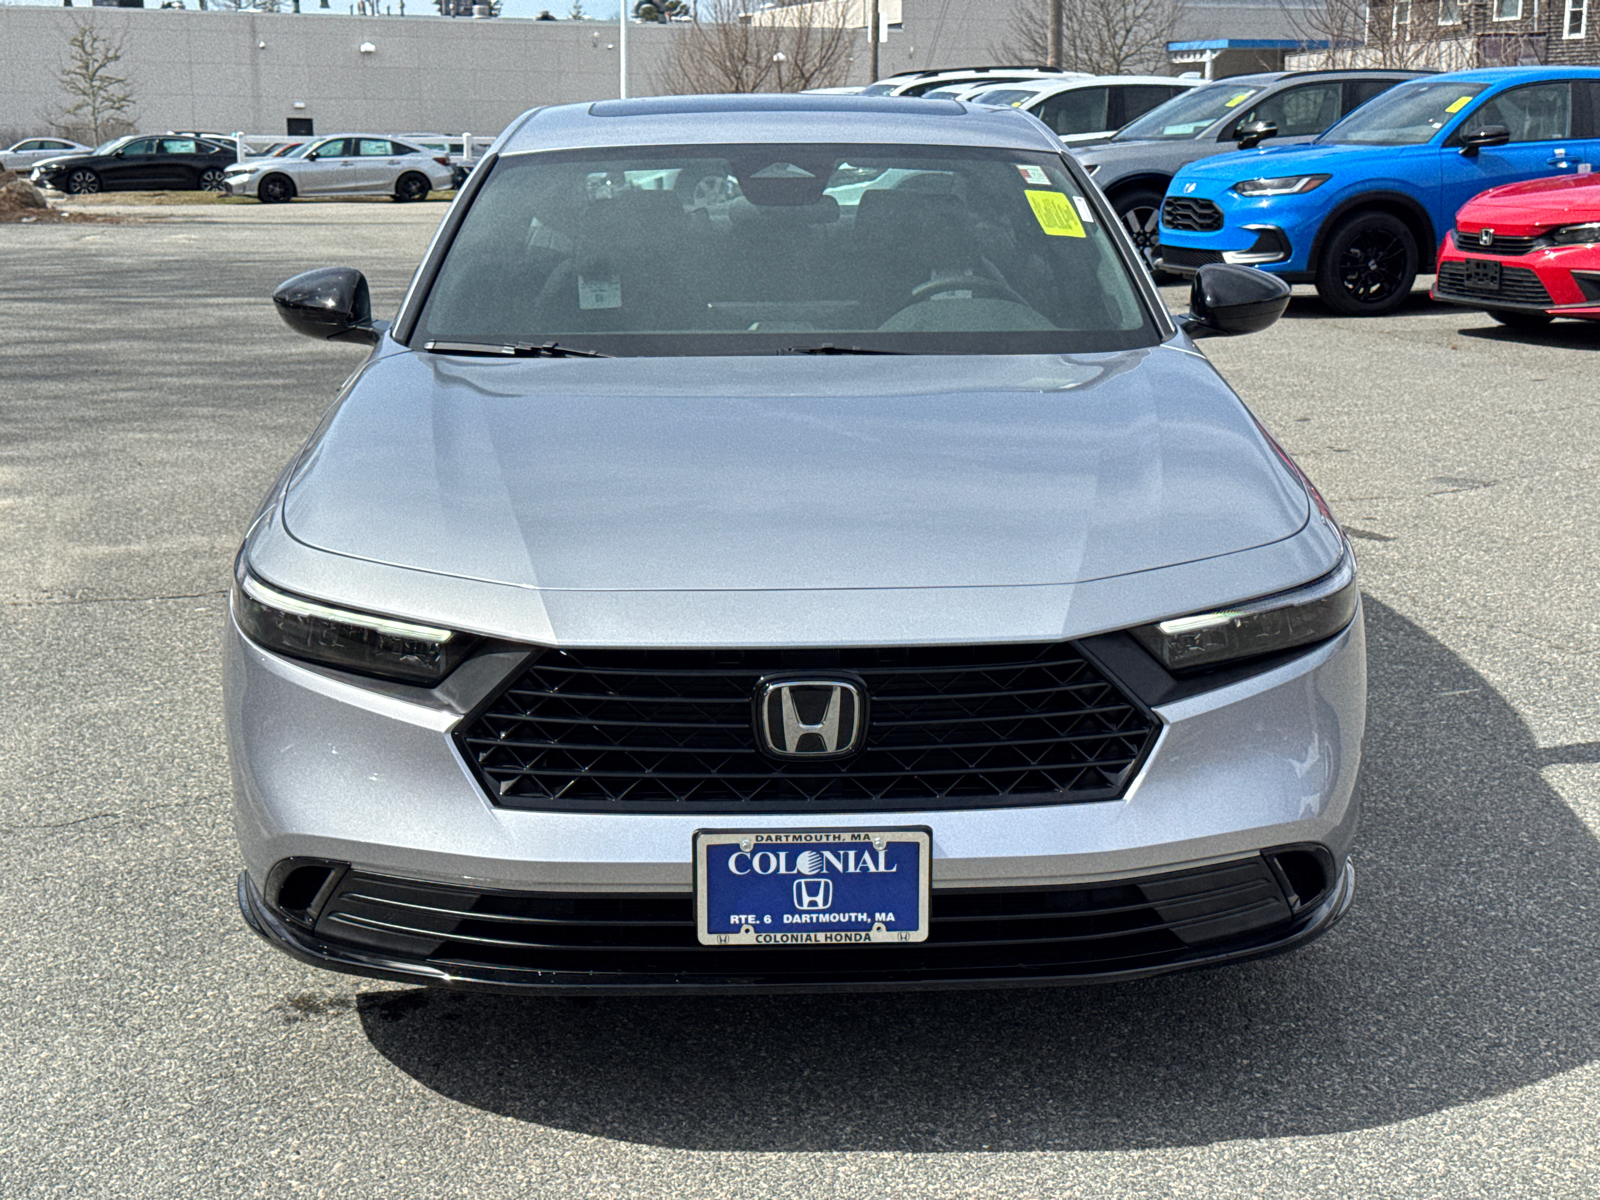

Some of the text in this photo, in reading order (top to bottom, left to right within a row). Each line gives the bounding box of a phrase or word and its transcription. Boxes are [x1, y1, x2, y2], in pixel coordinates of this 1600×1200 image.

[755, 833, 871, 843] DARTMOUTH, MA
[728, 849, 898, 875] COLONIAL
[730, 911, 896, 925] RTE. 6 DARTMOUTH, MA
[755, 932, 872, 943] COLONIAL HONDA
